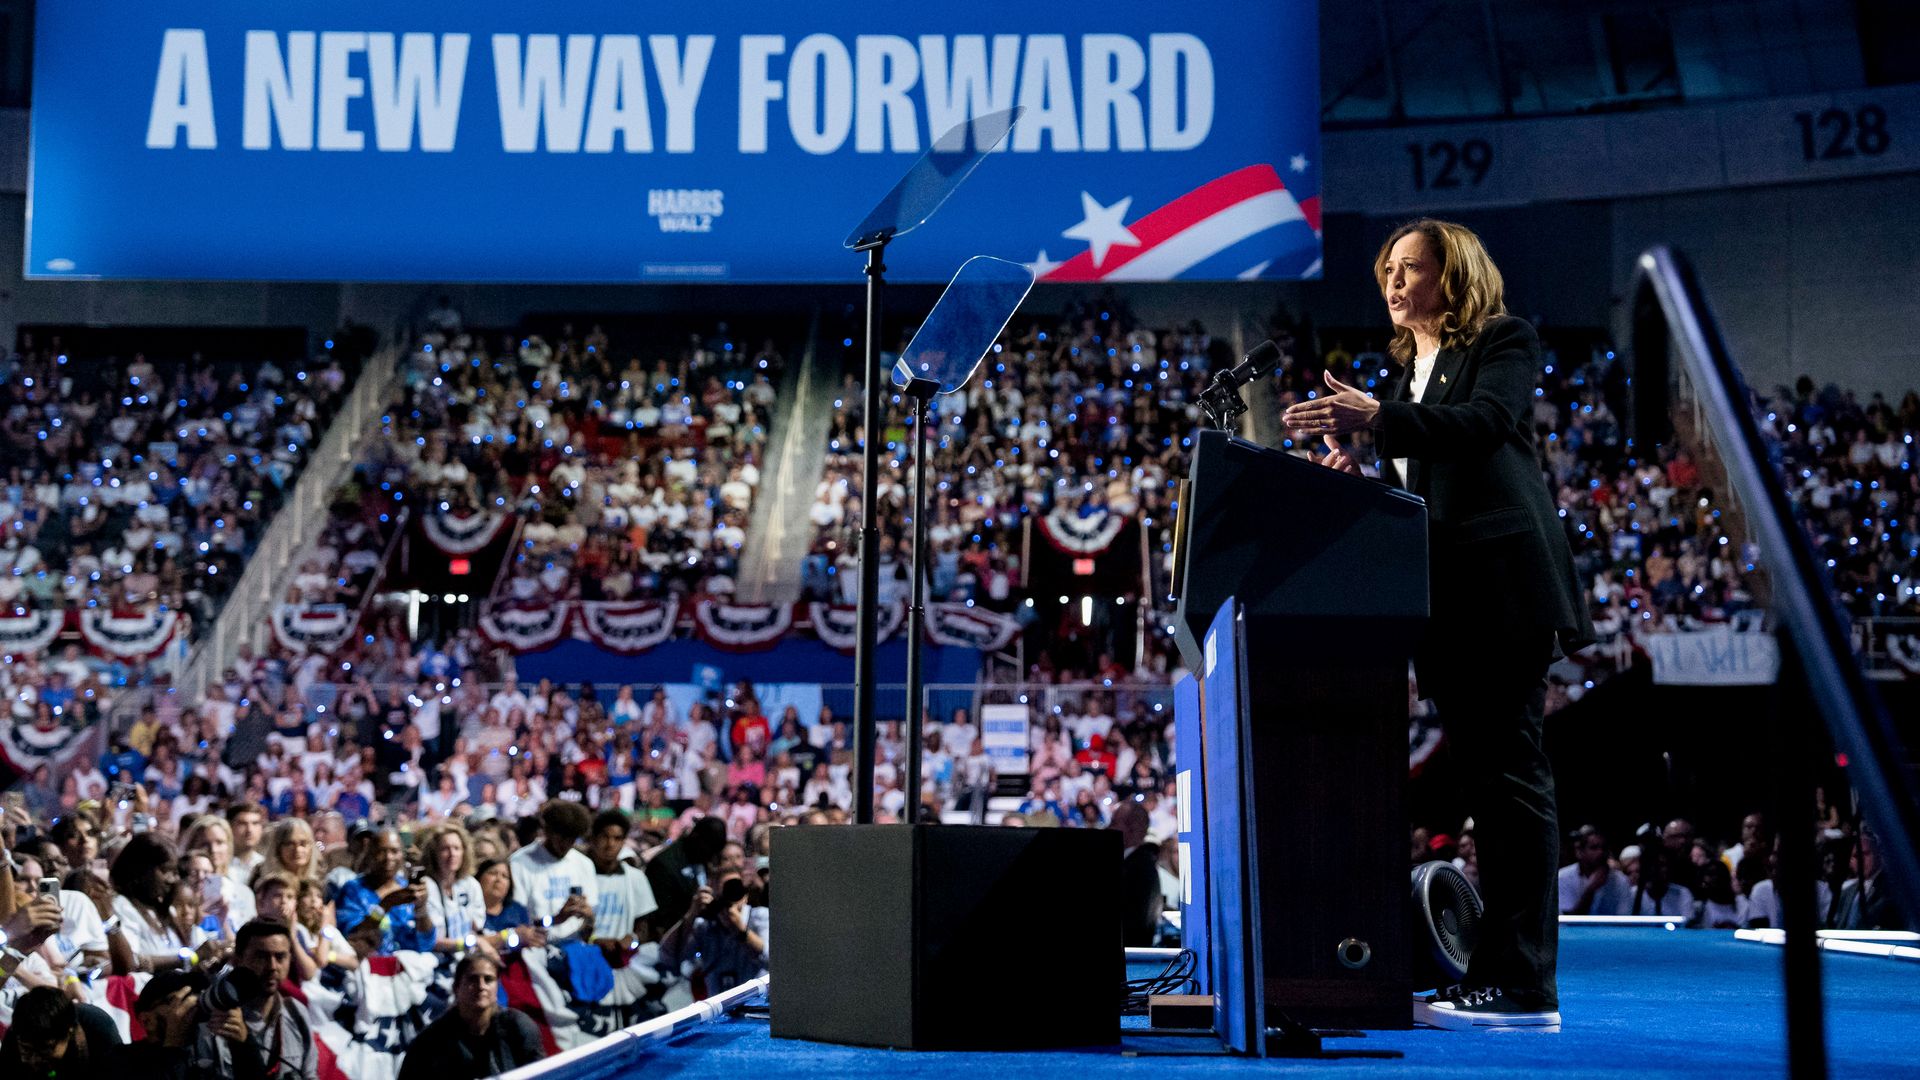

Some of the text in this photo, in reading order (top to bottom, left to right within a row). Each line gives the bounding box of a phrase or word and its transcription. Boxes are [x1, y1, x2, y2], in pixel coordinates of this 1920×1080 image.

[146, 29, 1215, 155] A NEW WAY FORWARD
[1794, 105, 1892, 162] 128
[1406, 138, 1495, 191] 129
[648, 189, 724, 216] HARRIS
[659, 214, 712, 232] WALZ
